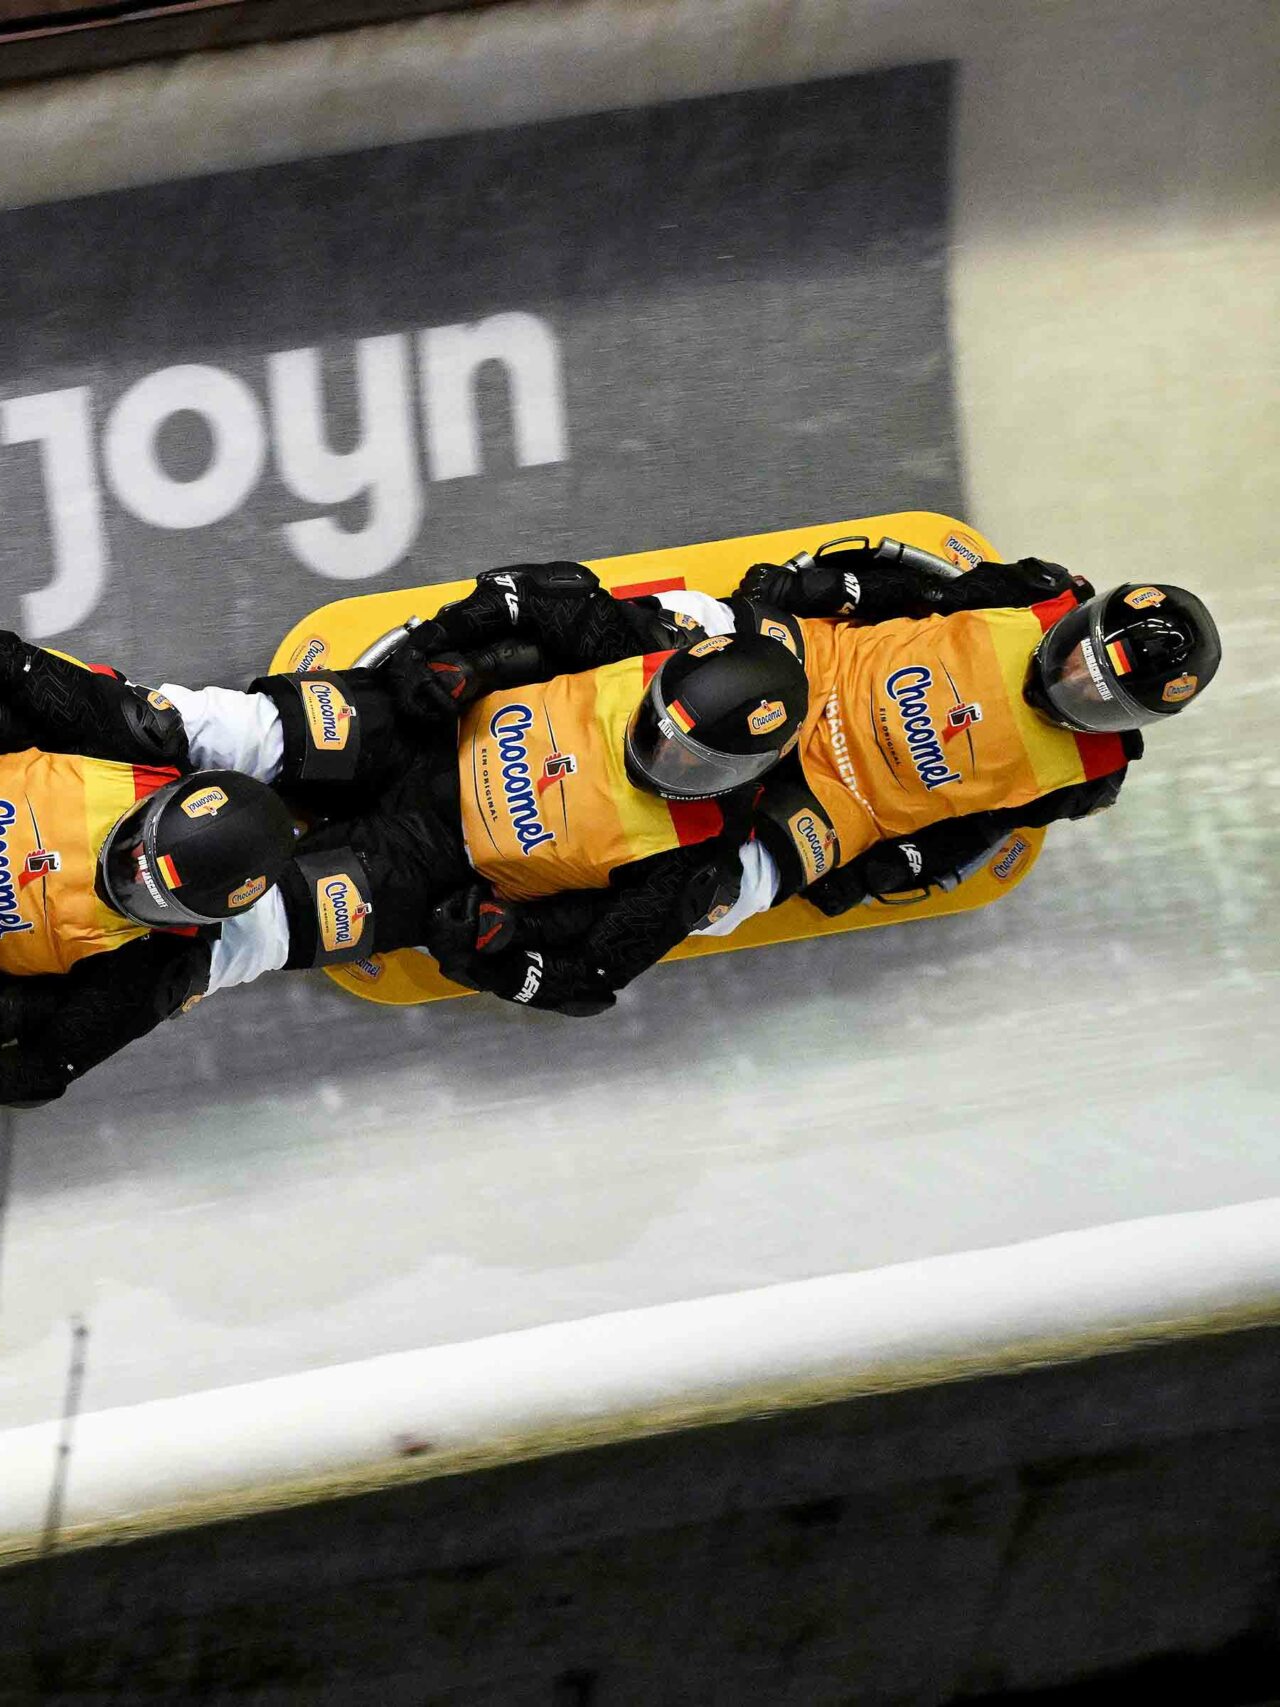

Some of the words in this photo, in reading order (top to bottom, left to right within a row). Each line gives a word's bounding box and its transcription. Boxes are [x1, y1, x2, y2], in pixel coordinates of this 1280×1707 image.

[309, 684, 341, 742] Chocomel
[879, 707, 887, 723] EIN
[885, 666, 961, 792] Chocomel
[482, 771, 499, 823] ORIGINAL
[489, 703, 554, 857] Chocomel
[325, 881, 354, 944] Chocomel
